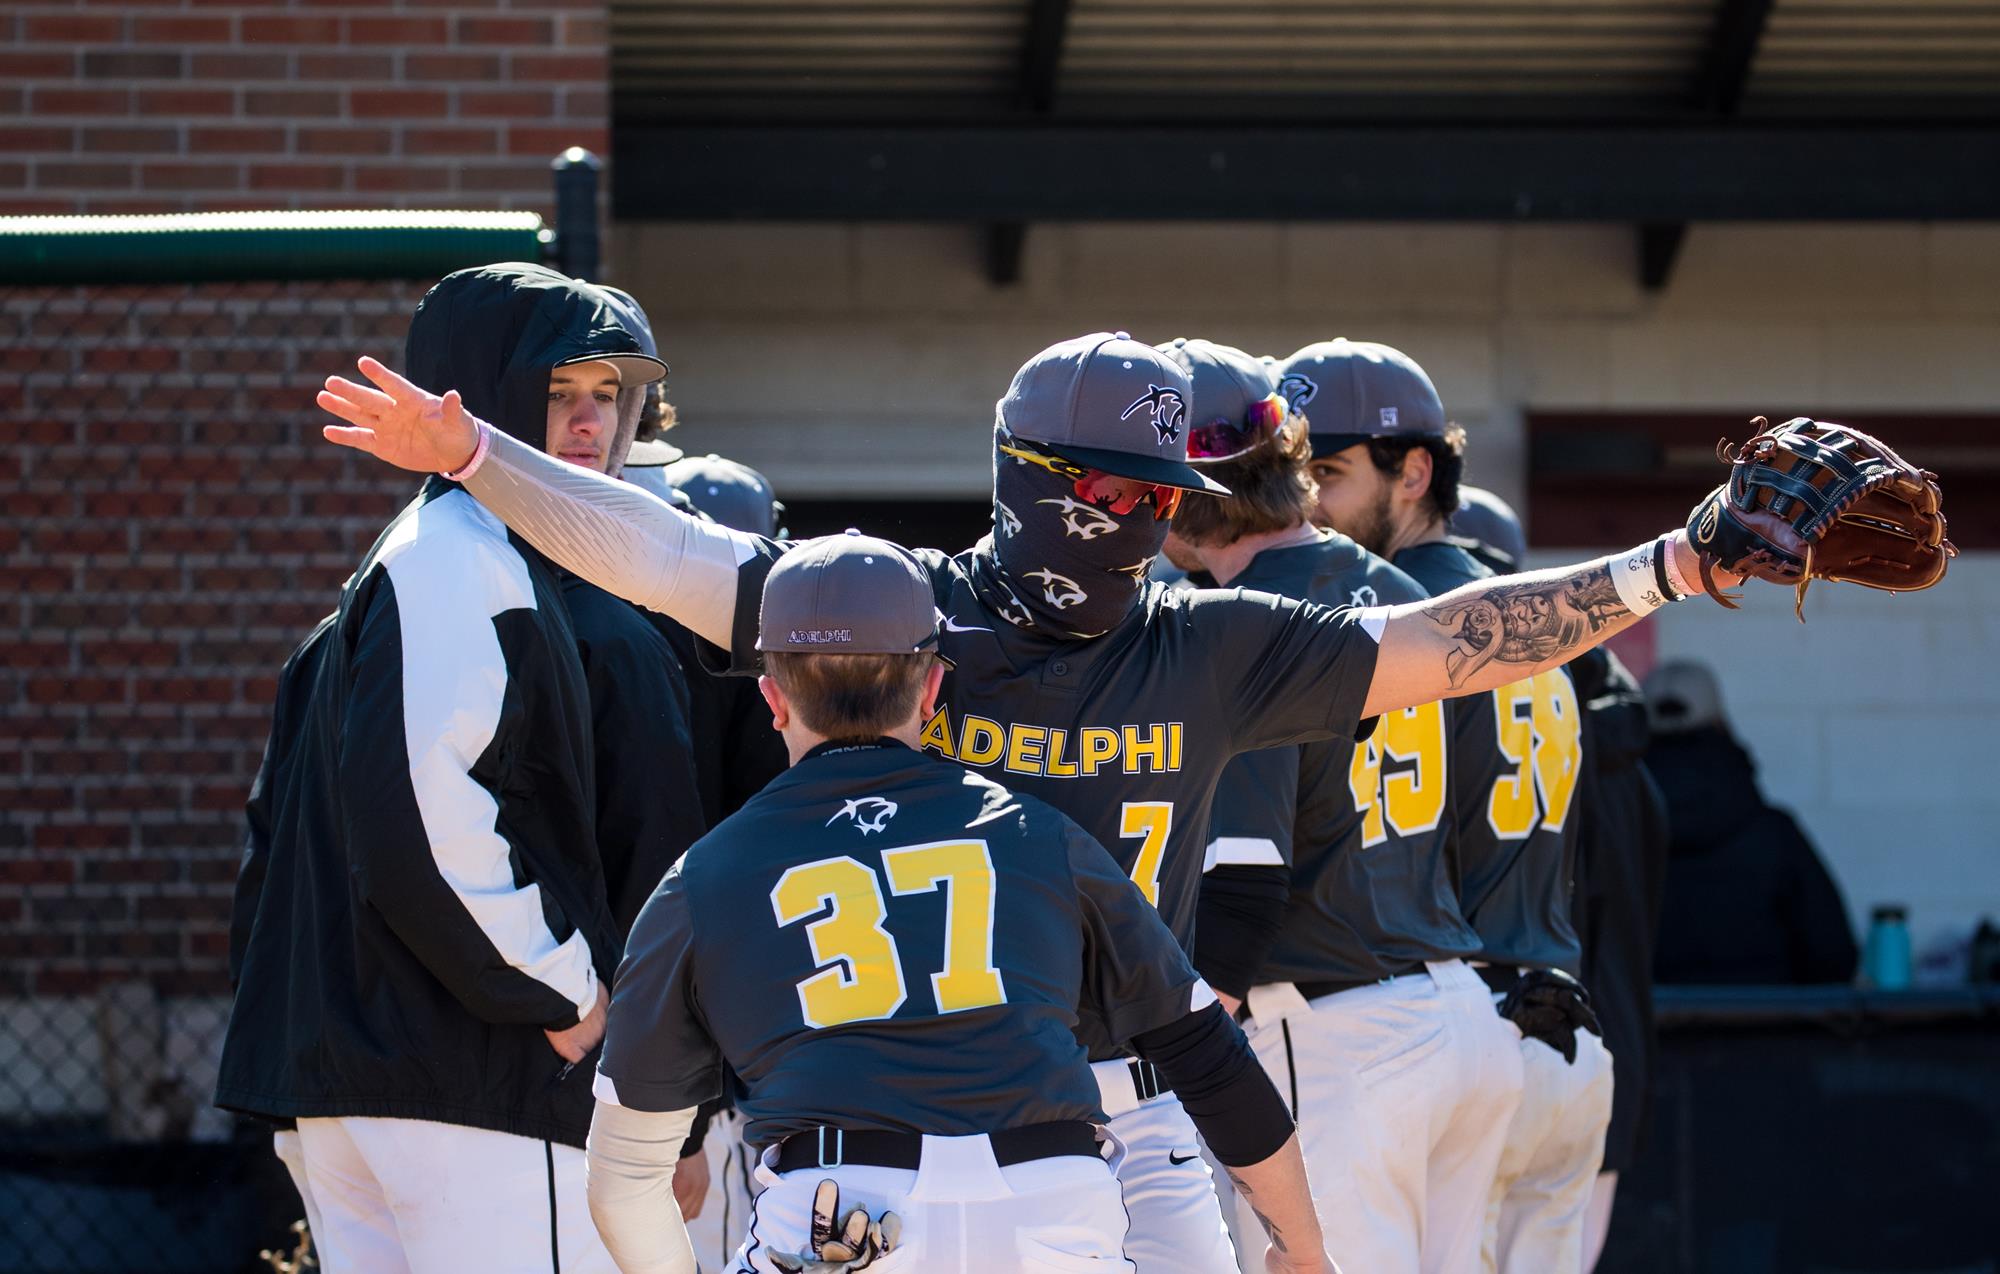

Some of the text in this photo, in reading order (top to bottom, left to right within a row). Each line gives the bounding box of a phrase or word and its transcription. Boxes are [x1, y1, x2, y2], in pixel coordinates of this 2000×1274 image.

[787, 629, 852, 643] ADELPHI
[921, 703, 1184, 778] ADELPHI
[1119, 801, 1174, 908] 7
[770, 839, 1008, 1029] 37
